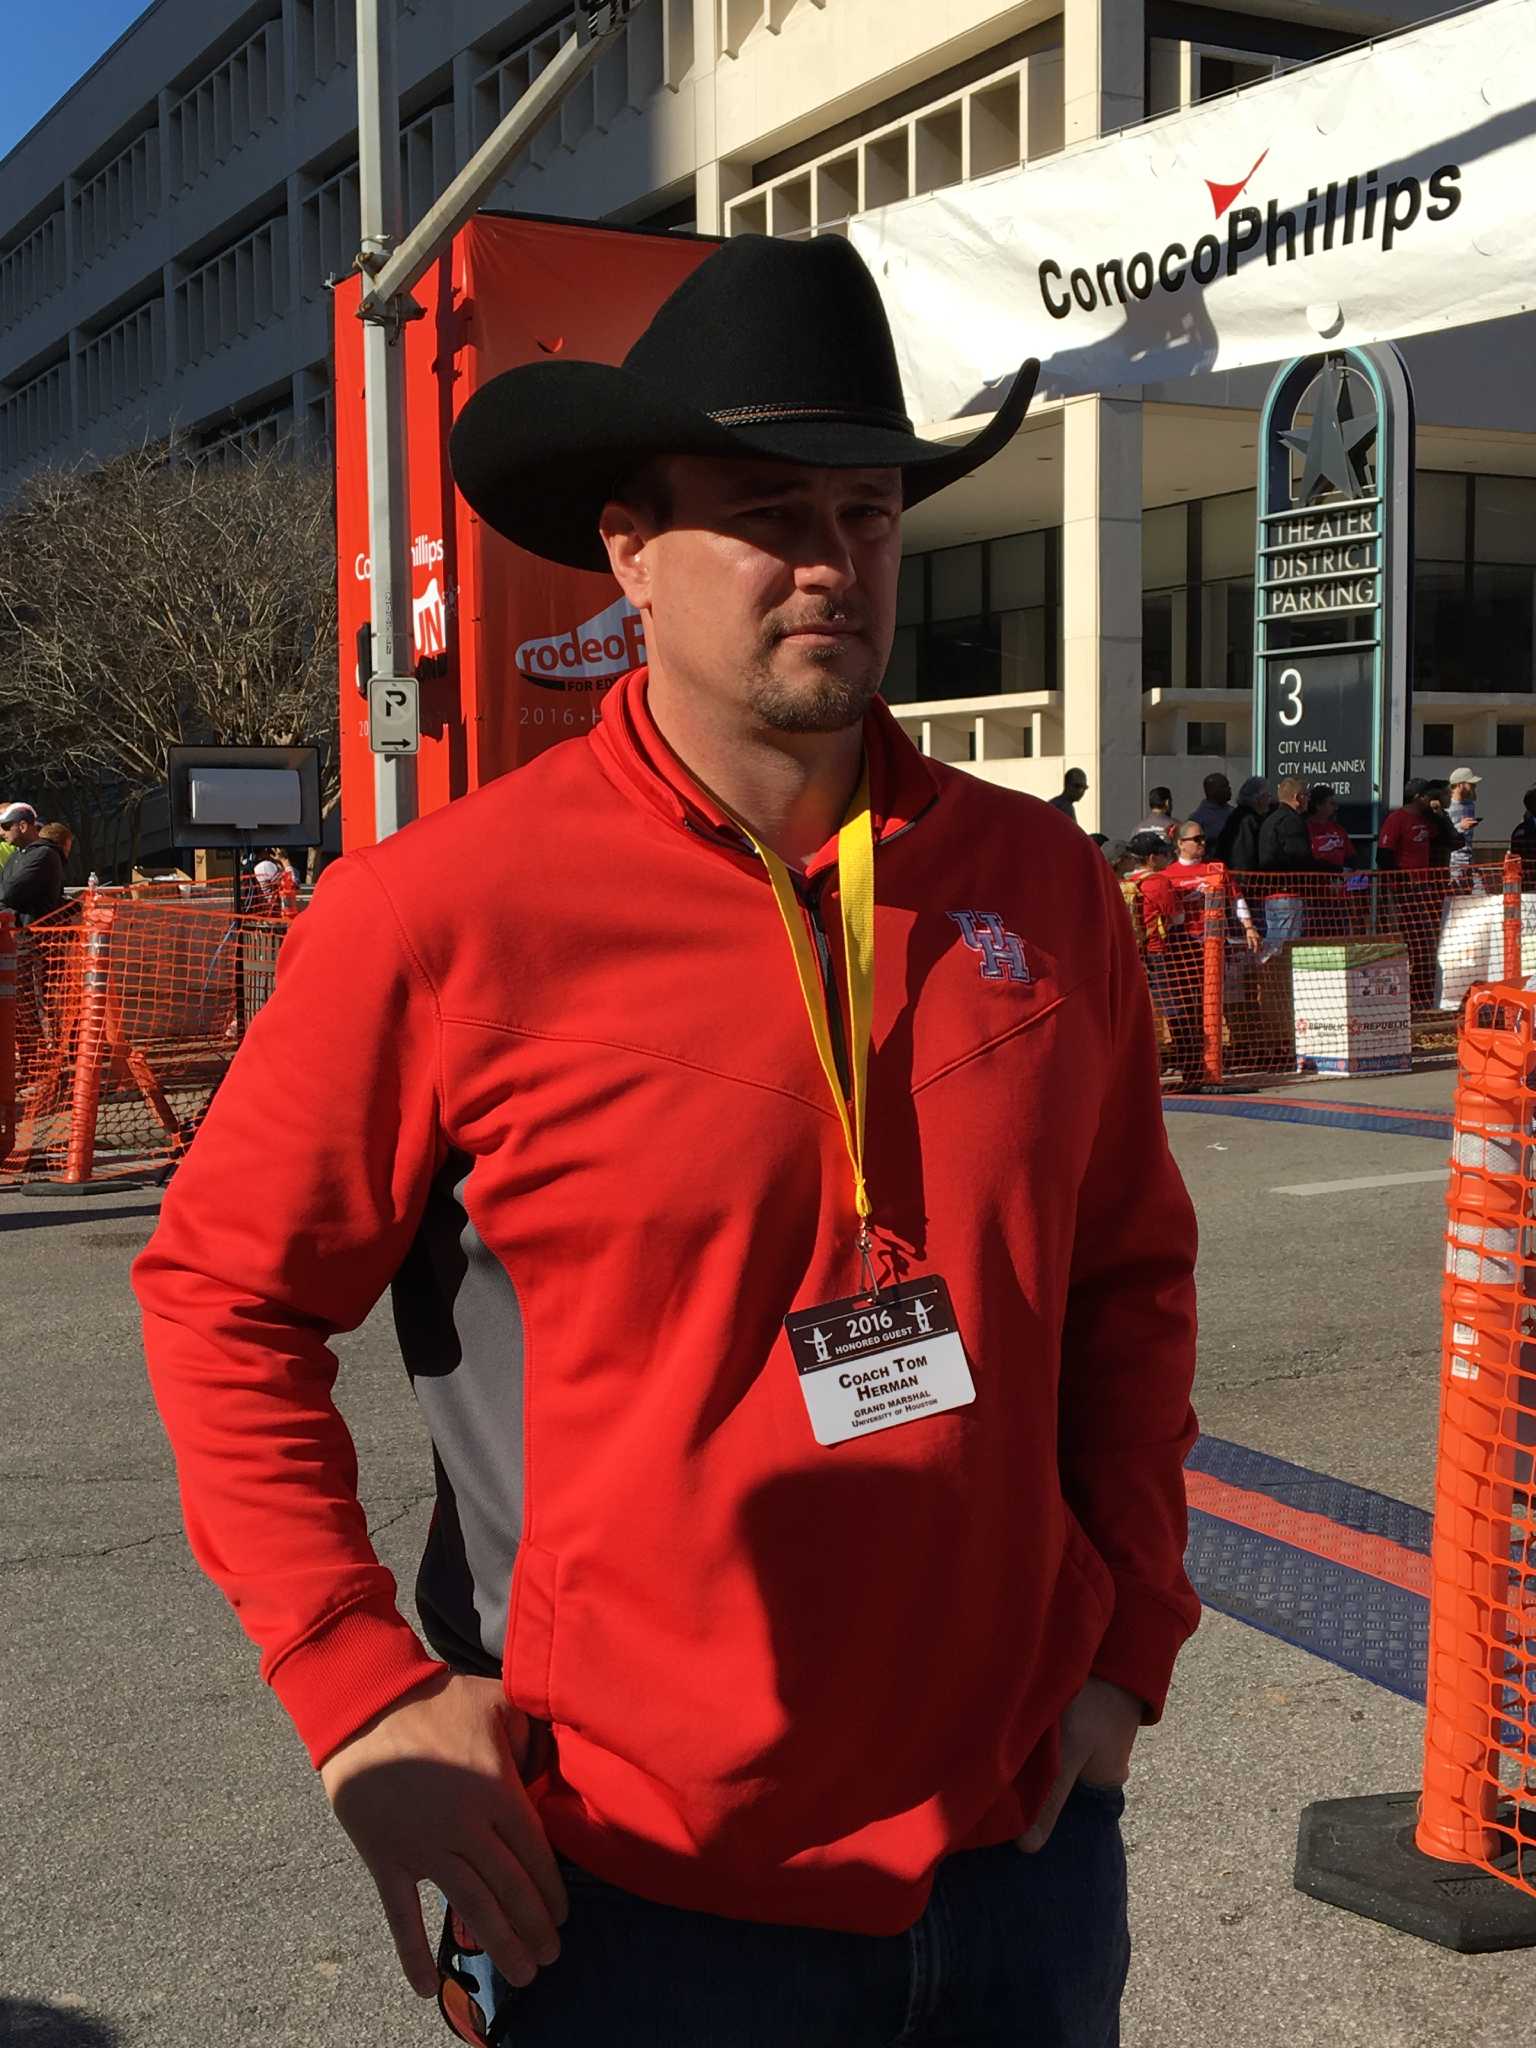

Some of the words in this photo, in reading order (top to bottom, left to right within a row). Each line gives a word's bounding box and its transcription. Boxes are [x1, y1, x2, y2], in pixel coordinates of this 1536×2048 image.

[1038, 165, 1462, 318] ConocoPhillips
[1277, 509, 1373, 544] THEATER
[1273, 543, 1373, 580] DISTRICT
[1272, 577, 1374, 614] PARKING
[1279, 668, 1302, 726] 3
[1278, 741, 1300, 754] CITY
[1303, 740, 1328, 753] HALL
[1278, 762, 1300, 775] CITY
[1303, 761, 1327, 774] HALL
[1330, 760, 1366, 773] ANNEX
[846, 1310, 893, 1339] 2016
[835, 1335, 880, 1355] HONORED
[882, 1326, 913, 1341] GUEST
[839, 1366, 890, 1389] COACH
[893, 1355, 928, 1373] TOM
[857, 1375, 919, 1401] HERMAN
[852, 1412, 892, 1428] UNIVERSITY
[905, 1399, 938, 1412] HOUSTON
[854, 1402, 885, 1418] GRAND
[887, 1390, 931, 1408] MARSHAL
